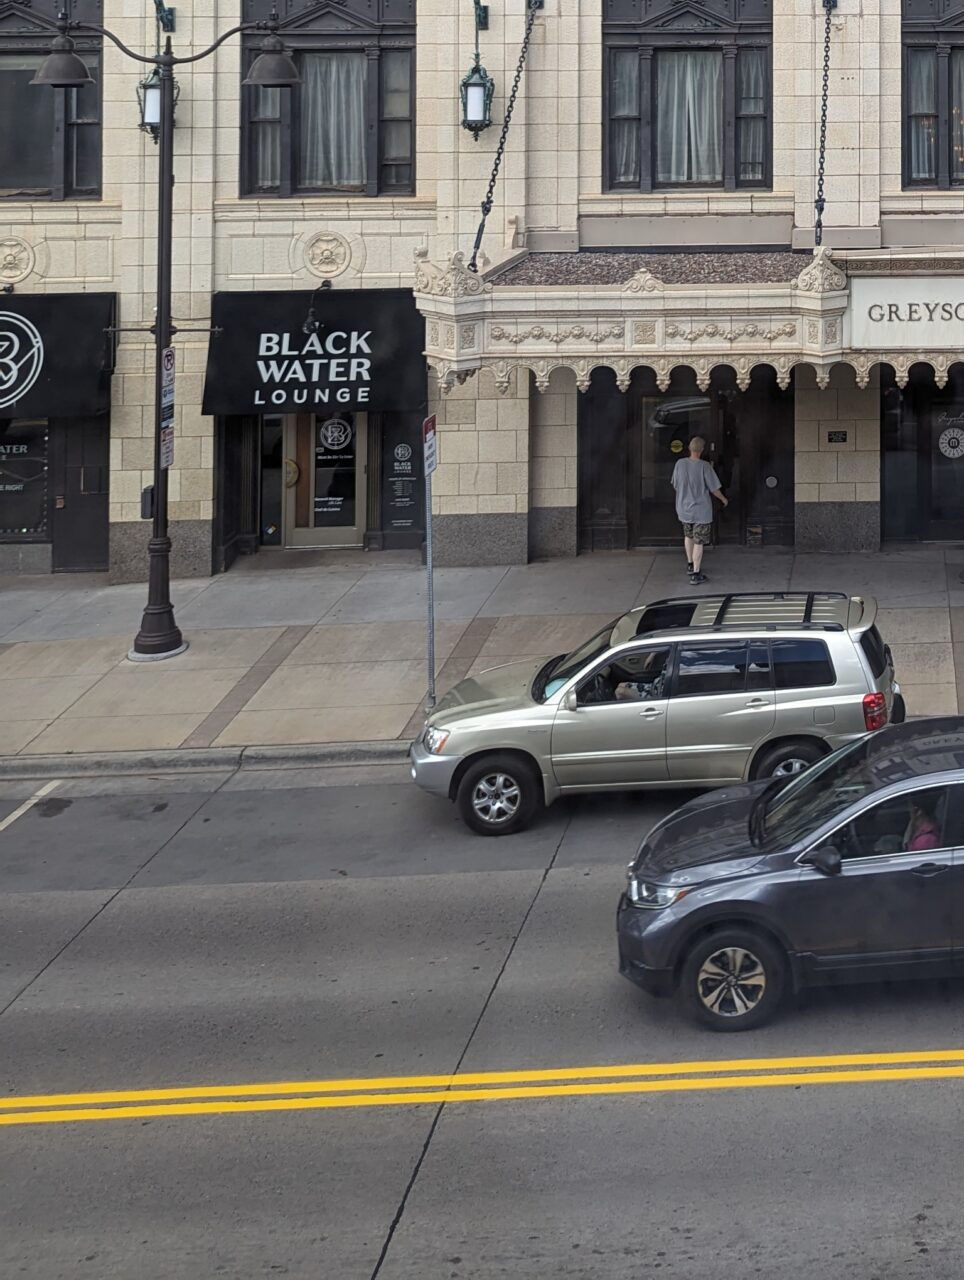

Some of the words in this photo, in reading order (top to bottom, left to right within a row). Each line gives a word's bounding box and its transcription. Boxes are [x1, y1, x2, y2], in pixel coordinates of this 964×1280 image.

[258, 331, 373, 356] BLACK
[256, 358, 372, 383] WATER
[254, 387, 371, 405] LOUNGE
